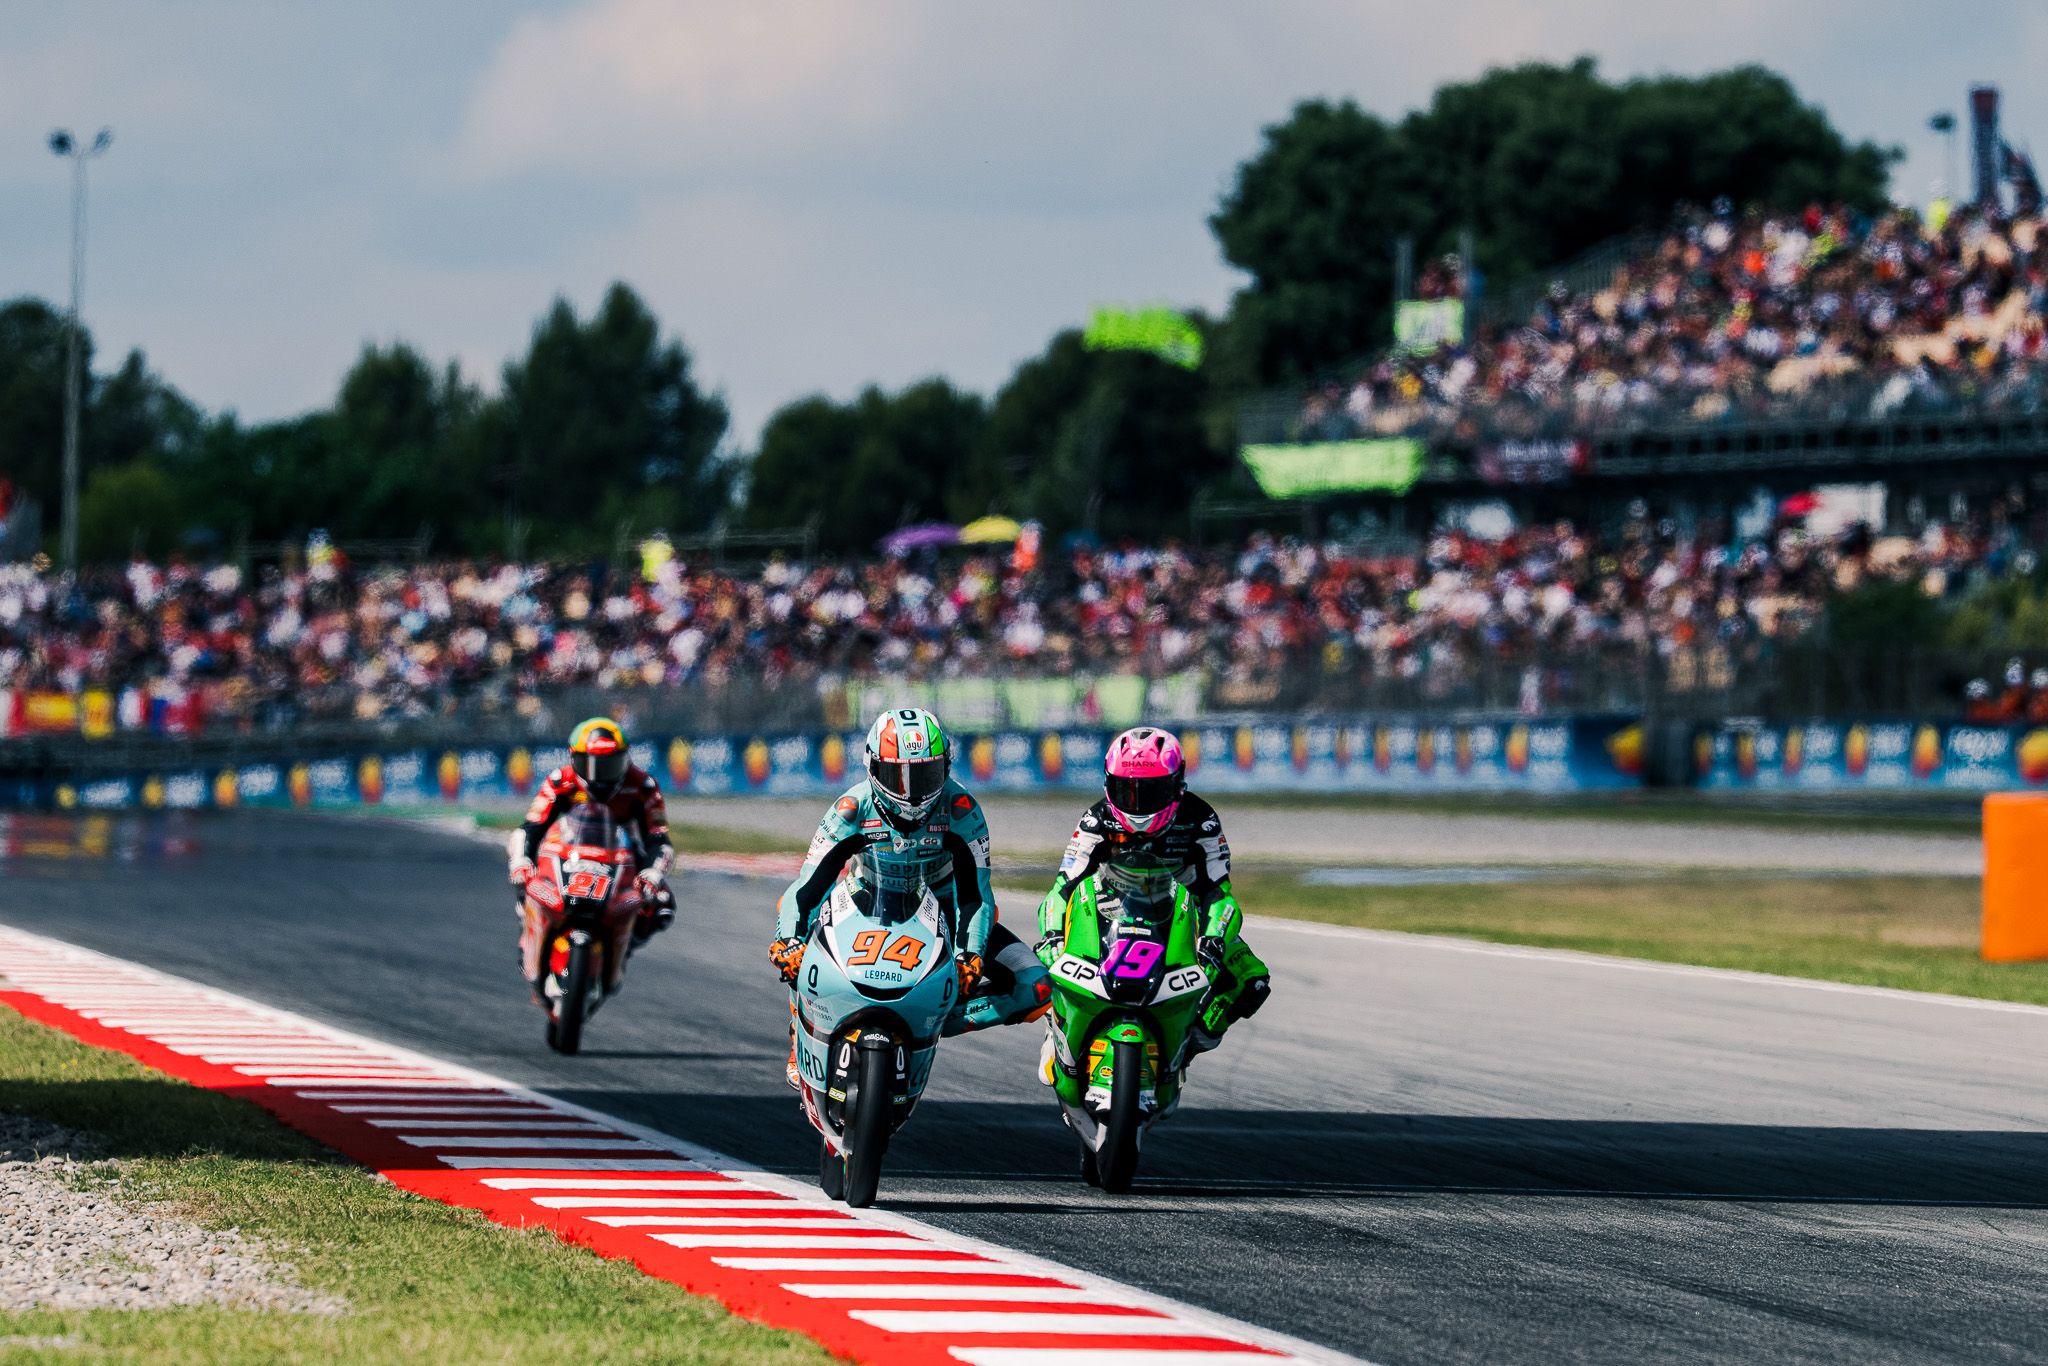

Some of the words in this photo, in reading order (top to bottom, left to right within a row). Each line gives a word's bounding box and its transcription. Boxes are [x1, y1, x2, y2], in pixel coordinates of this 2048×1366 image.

[906, 742, 922, 751] agv
[567, 873, 609, 900] 21
[847, 930, 926, 972] 94
[1096, 939, 1165, 978] 19
[864, 970, 903, 982] LEOPARD
[1060, 961, 1096, 980] CIP
[1168, 971, 1200, 991] CIP
